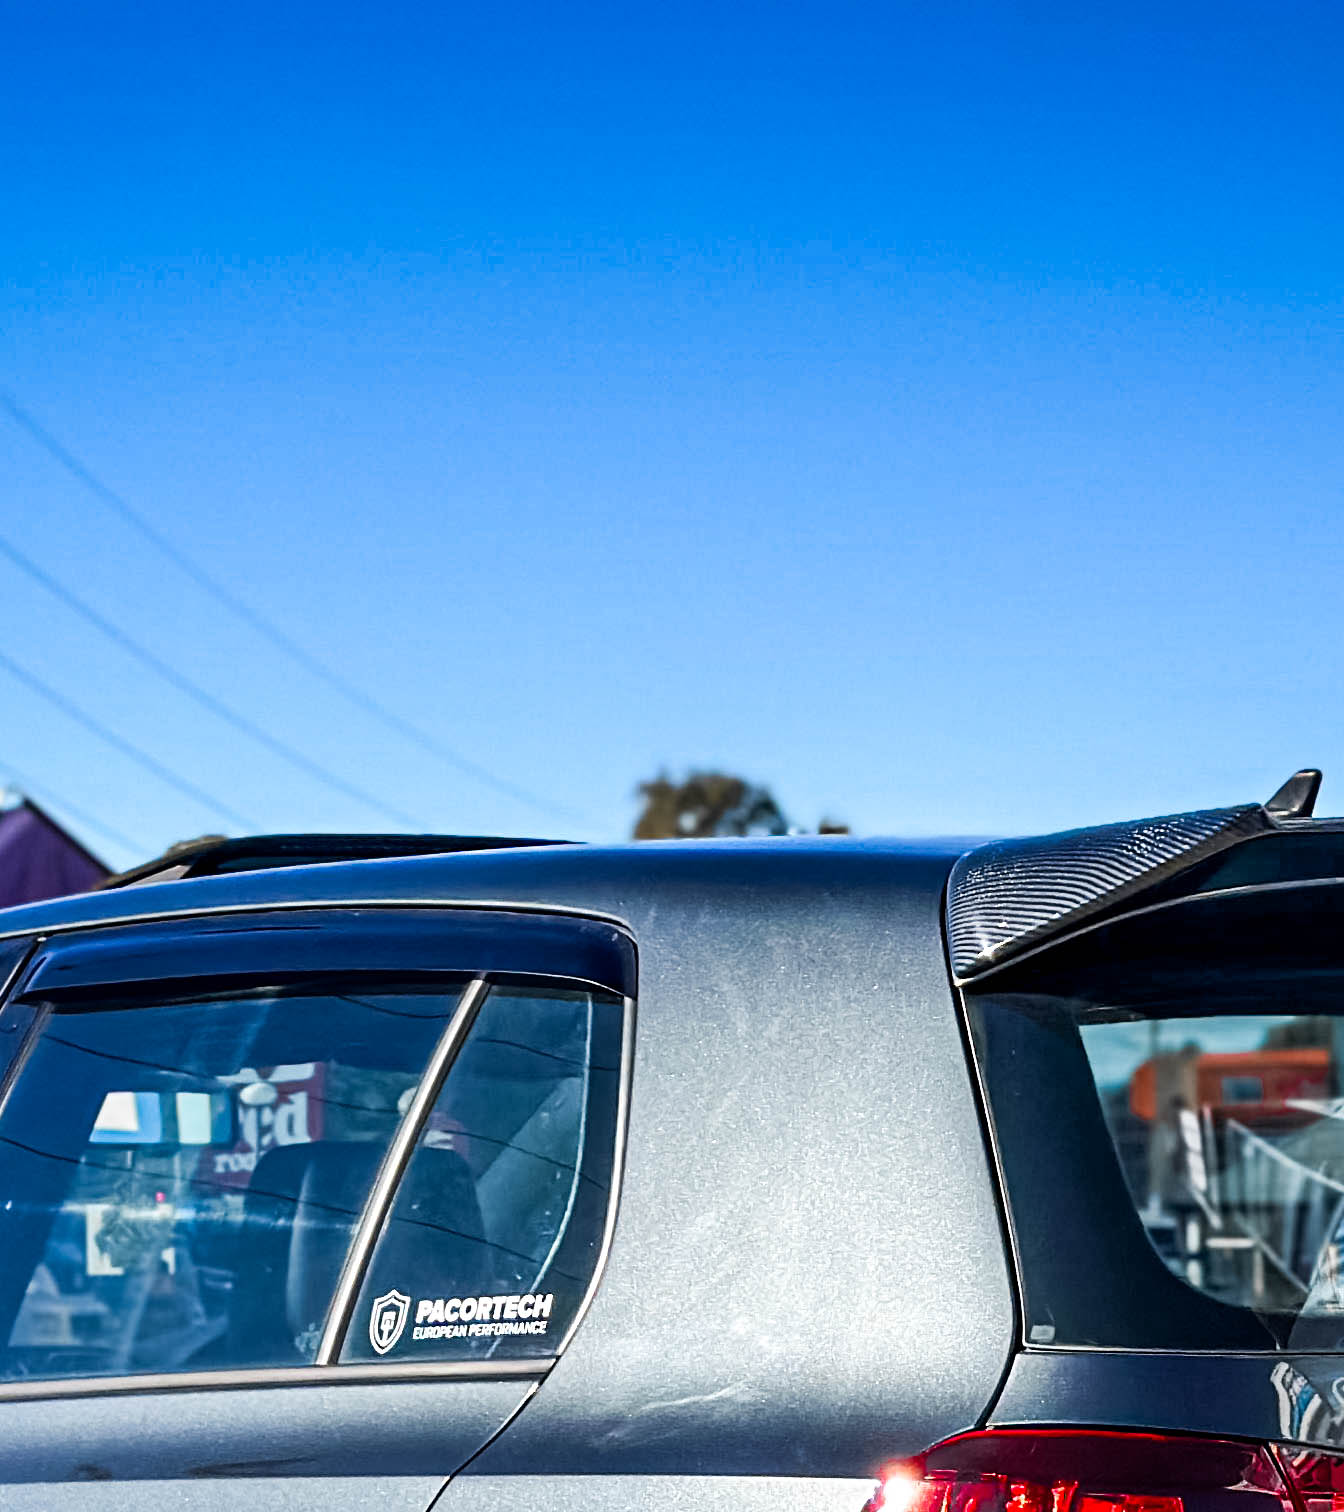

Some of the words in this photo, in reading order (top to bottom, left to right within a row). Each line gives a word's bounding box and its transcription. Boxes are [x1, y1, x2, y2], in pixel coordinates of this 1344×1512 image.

[415, 1293, 554, 1325] PACORTECH
[412, 1324, 467, 1340] EUROPEAN
[467, 1319, 548, 1338] PERFORMANCE
